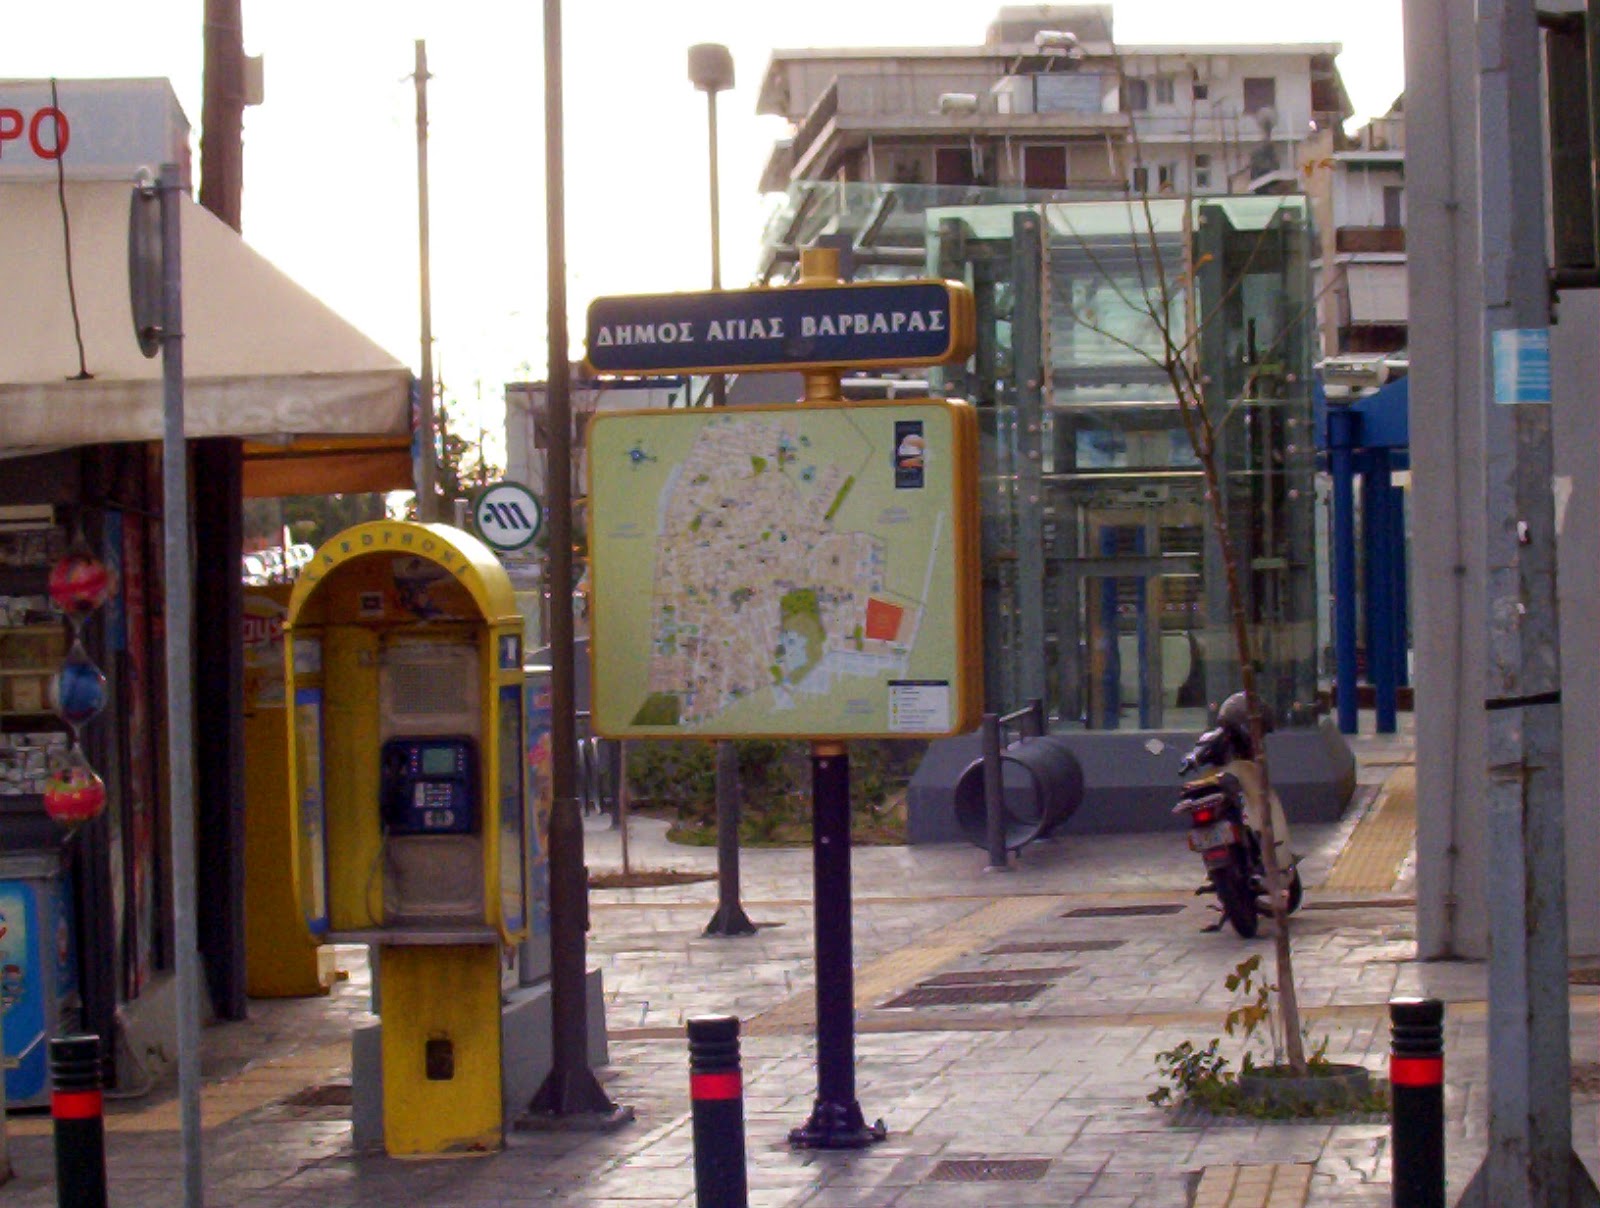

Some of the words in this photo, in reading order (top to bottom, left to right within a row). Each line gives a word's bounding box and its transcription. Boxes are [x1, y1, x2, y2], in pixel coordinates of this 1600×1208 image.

[597, 323, 695, 346] ΔΗΜΟΣ
[706, 317, 785, 342] ΑΓΙΑΣ
[801, 310, 944, 337] ΒΑΡΒΑΡΑΣ
